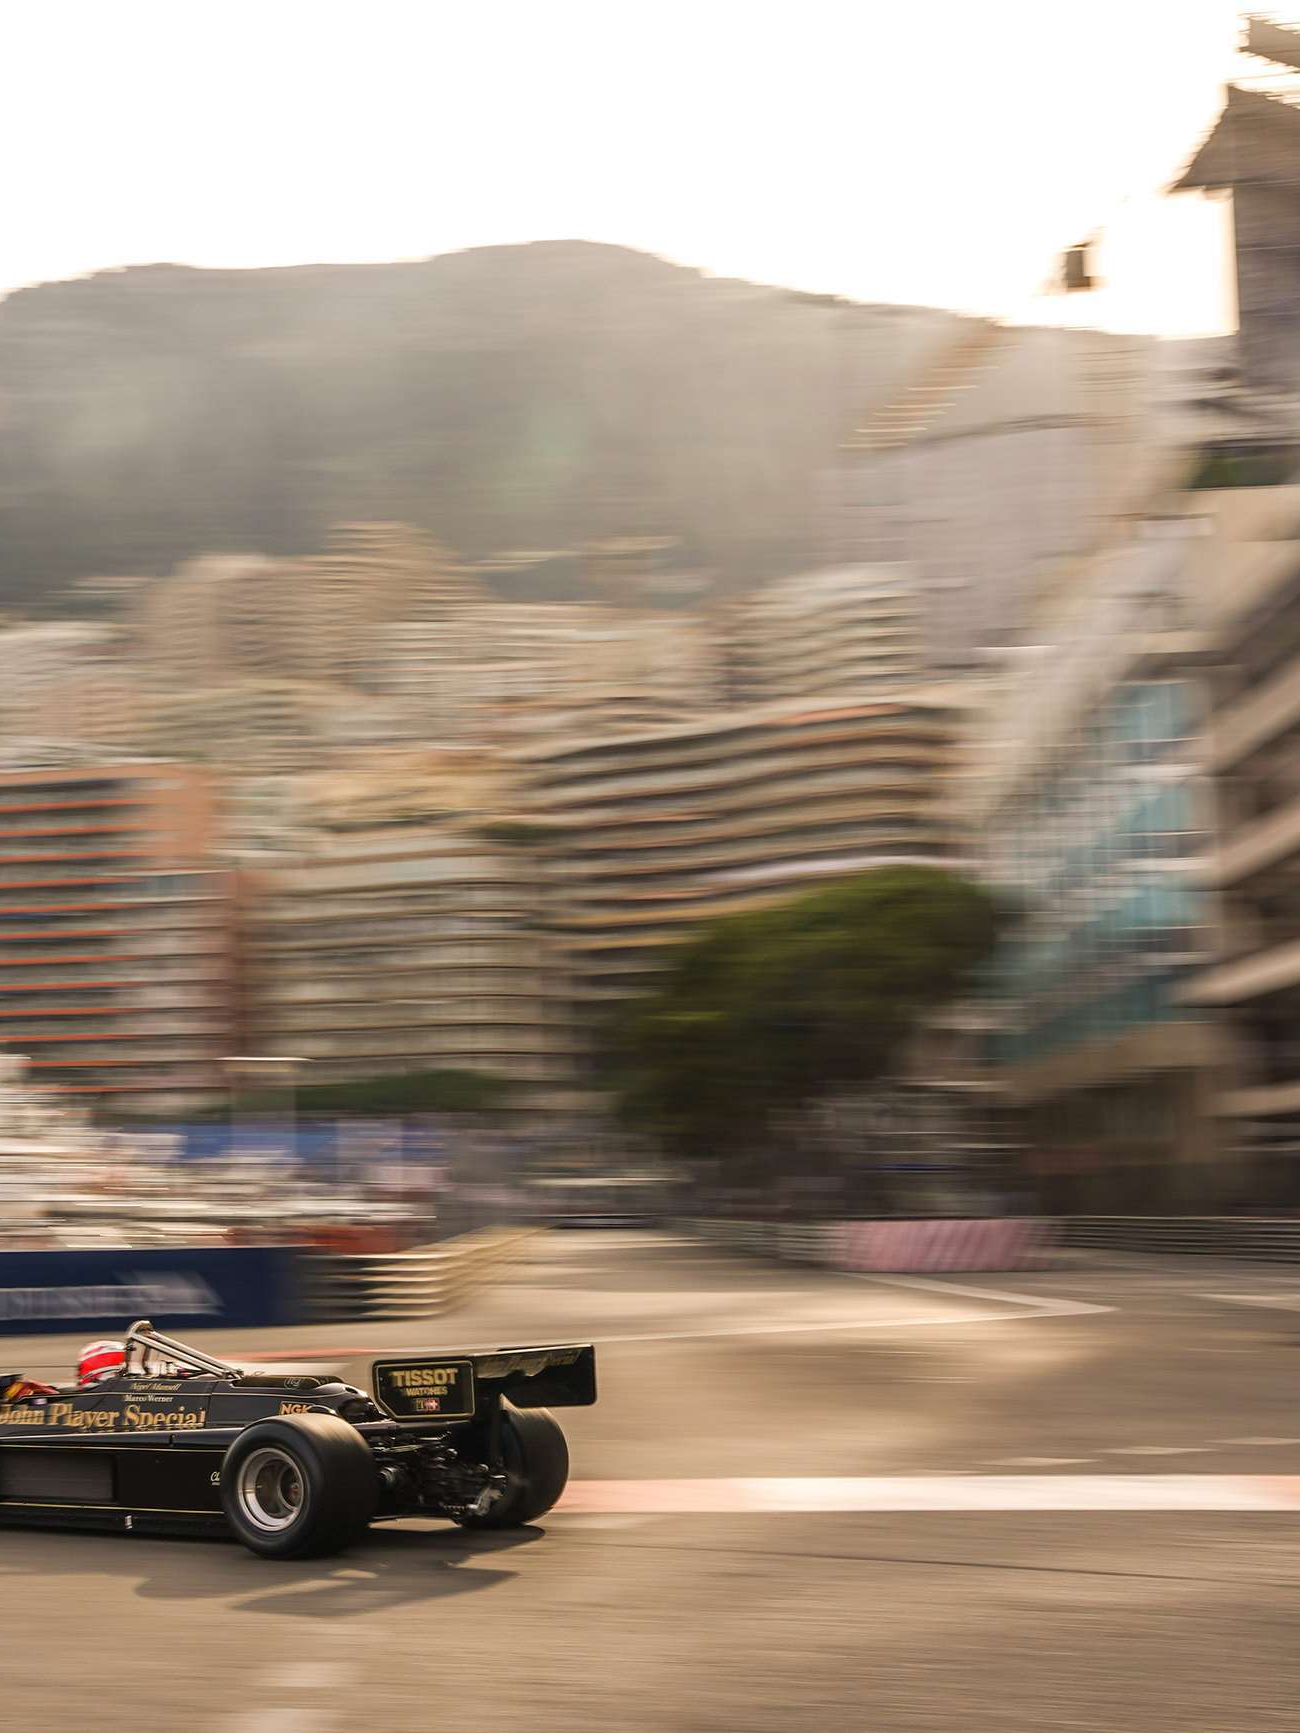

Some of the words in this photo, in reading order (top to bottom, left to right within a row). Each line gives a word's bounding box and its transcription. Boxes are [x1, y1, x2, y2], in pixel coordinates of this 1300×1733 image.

[390, 1368, 458, 1387] TISSOT
[123, 1394, 147, 1402] Marco
[148, 1394, 174, 1403] Werner
[46, 1403, 120, 1429] Player
[124, 1405, 206, 1429] Special
[280, 1403, 313, 1415] NGK
